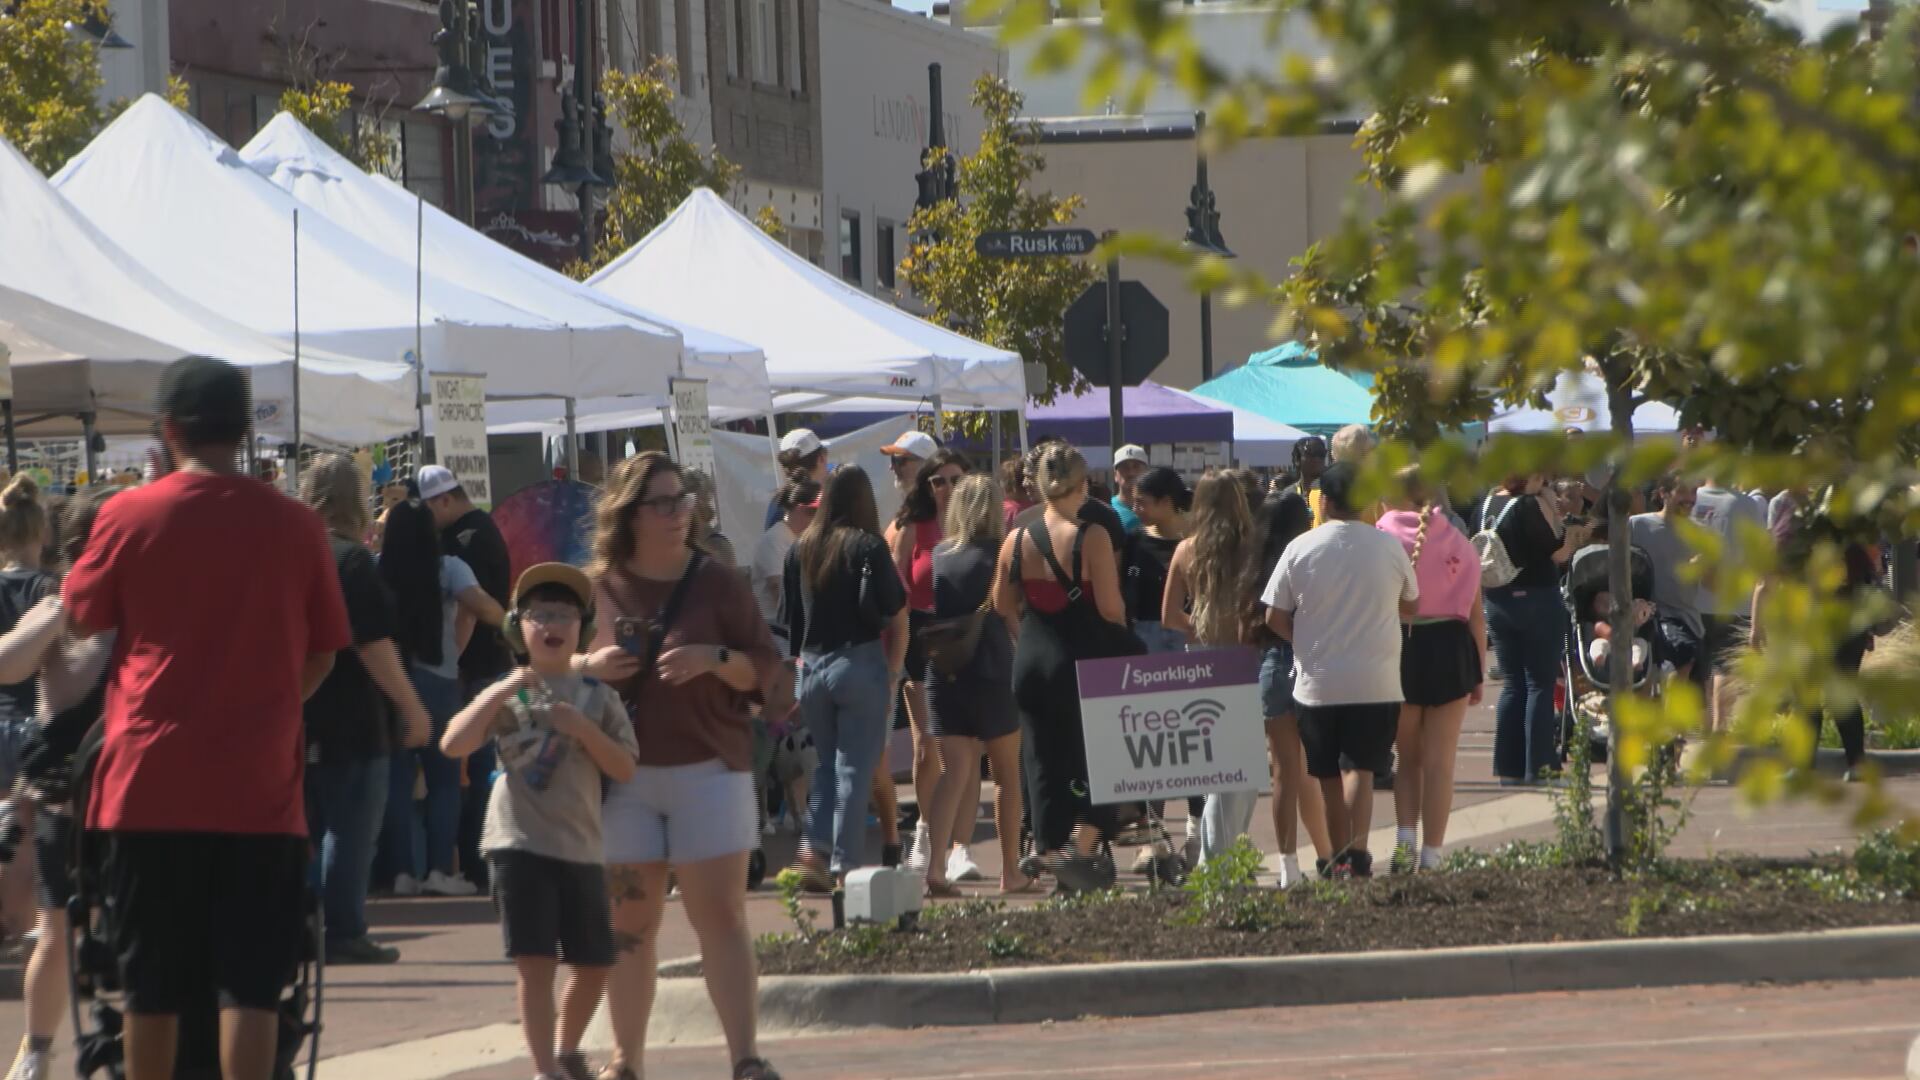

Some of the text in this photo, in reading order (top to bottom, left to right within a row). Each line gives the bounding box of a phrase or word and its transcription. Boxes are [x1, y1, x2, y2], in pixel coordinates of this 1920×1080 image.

[1010, 233, 1083, 253] Rusk Ave
[1132, 663, 1213, 687] Sparklight
[1118, 705, 1181, 733] free
[1124, 726, 1213, 769] WiFi
[1113, 769, 1248, 794] always connected.
